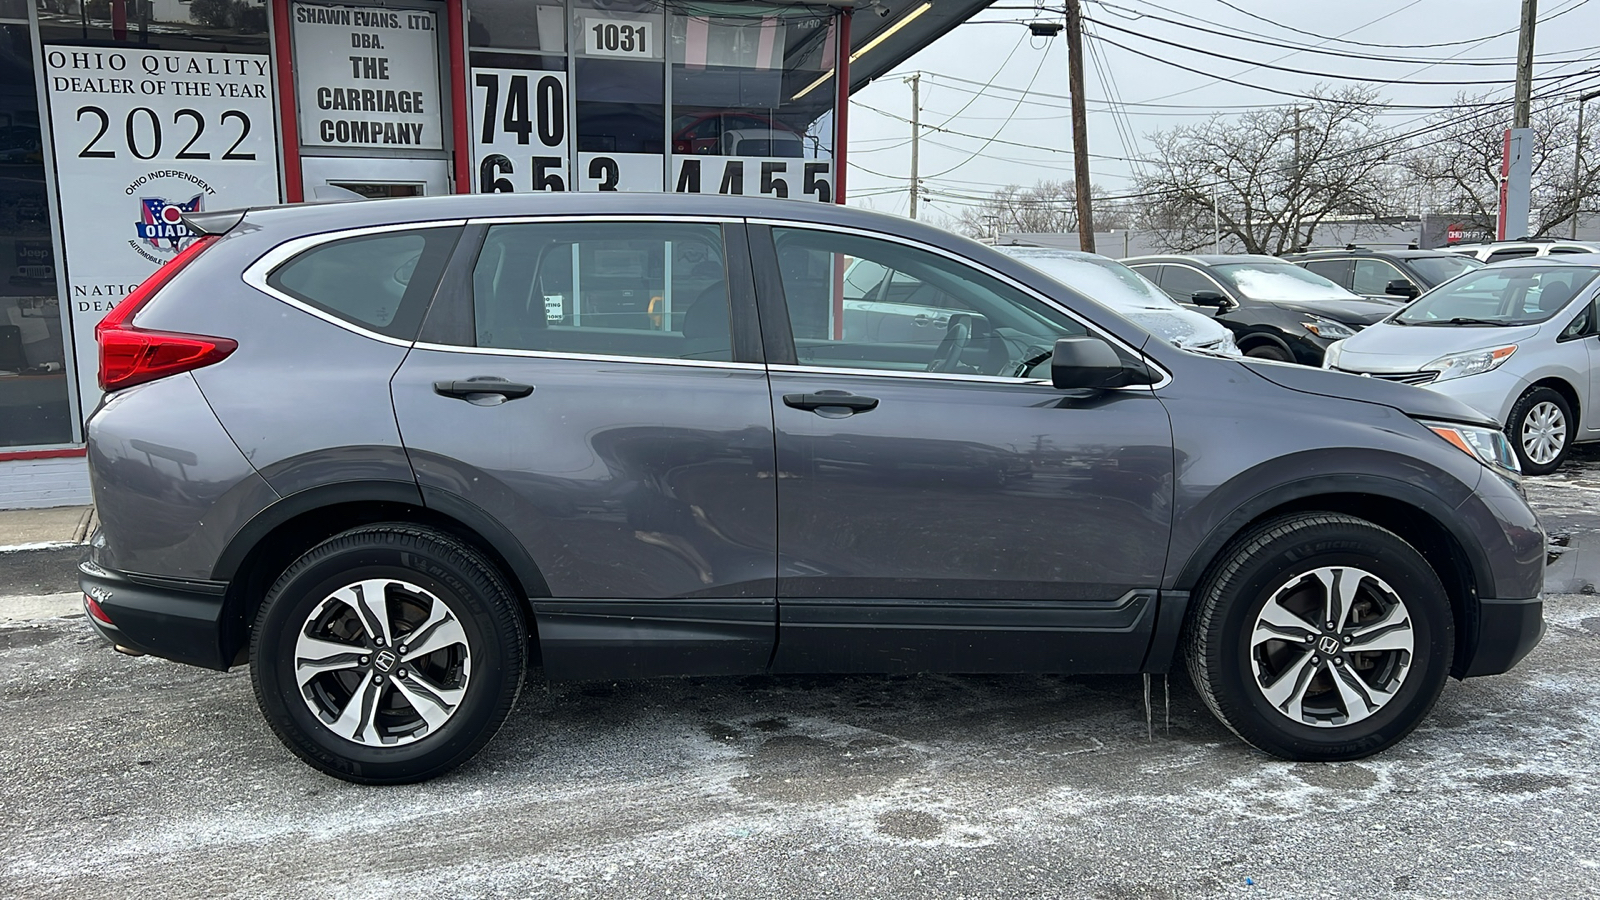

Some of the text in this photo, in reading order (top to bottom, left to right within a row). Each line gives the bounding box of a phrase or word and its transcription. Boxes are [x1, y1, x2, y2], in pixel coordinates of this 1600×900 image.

[296, 7, 435, 31] SHAWN EVANS. LTD.
[351, 32, 385, 50] DBA.
[592, 23, 646, 52] 1031
[48, 51, 268, 76] OHIO QUALITY
[349, 56, 390, 80] THE
[53, 77, 268, 98] DEALER OF THE YEAR
[317, 87, 424, 113] CARRIAGE
[475, 73, 565, 147] 740
[76, 105, 257, 160] 2022
[320, 119, 424, 145] COMPANY
[125, 170, 216, 195] OHIO INDEPENDENT
[20, 247, 49, 259] Jeep
[128, 239, 162, 265] AUTOMOBILE
[74, 284, 139, 297] NATIO
[78, 301, 115, 312] DEA
